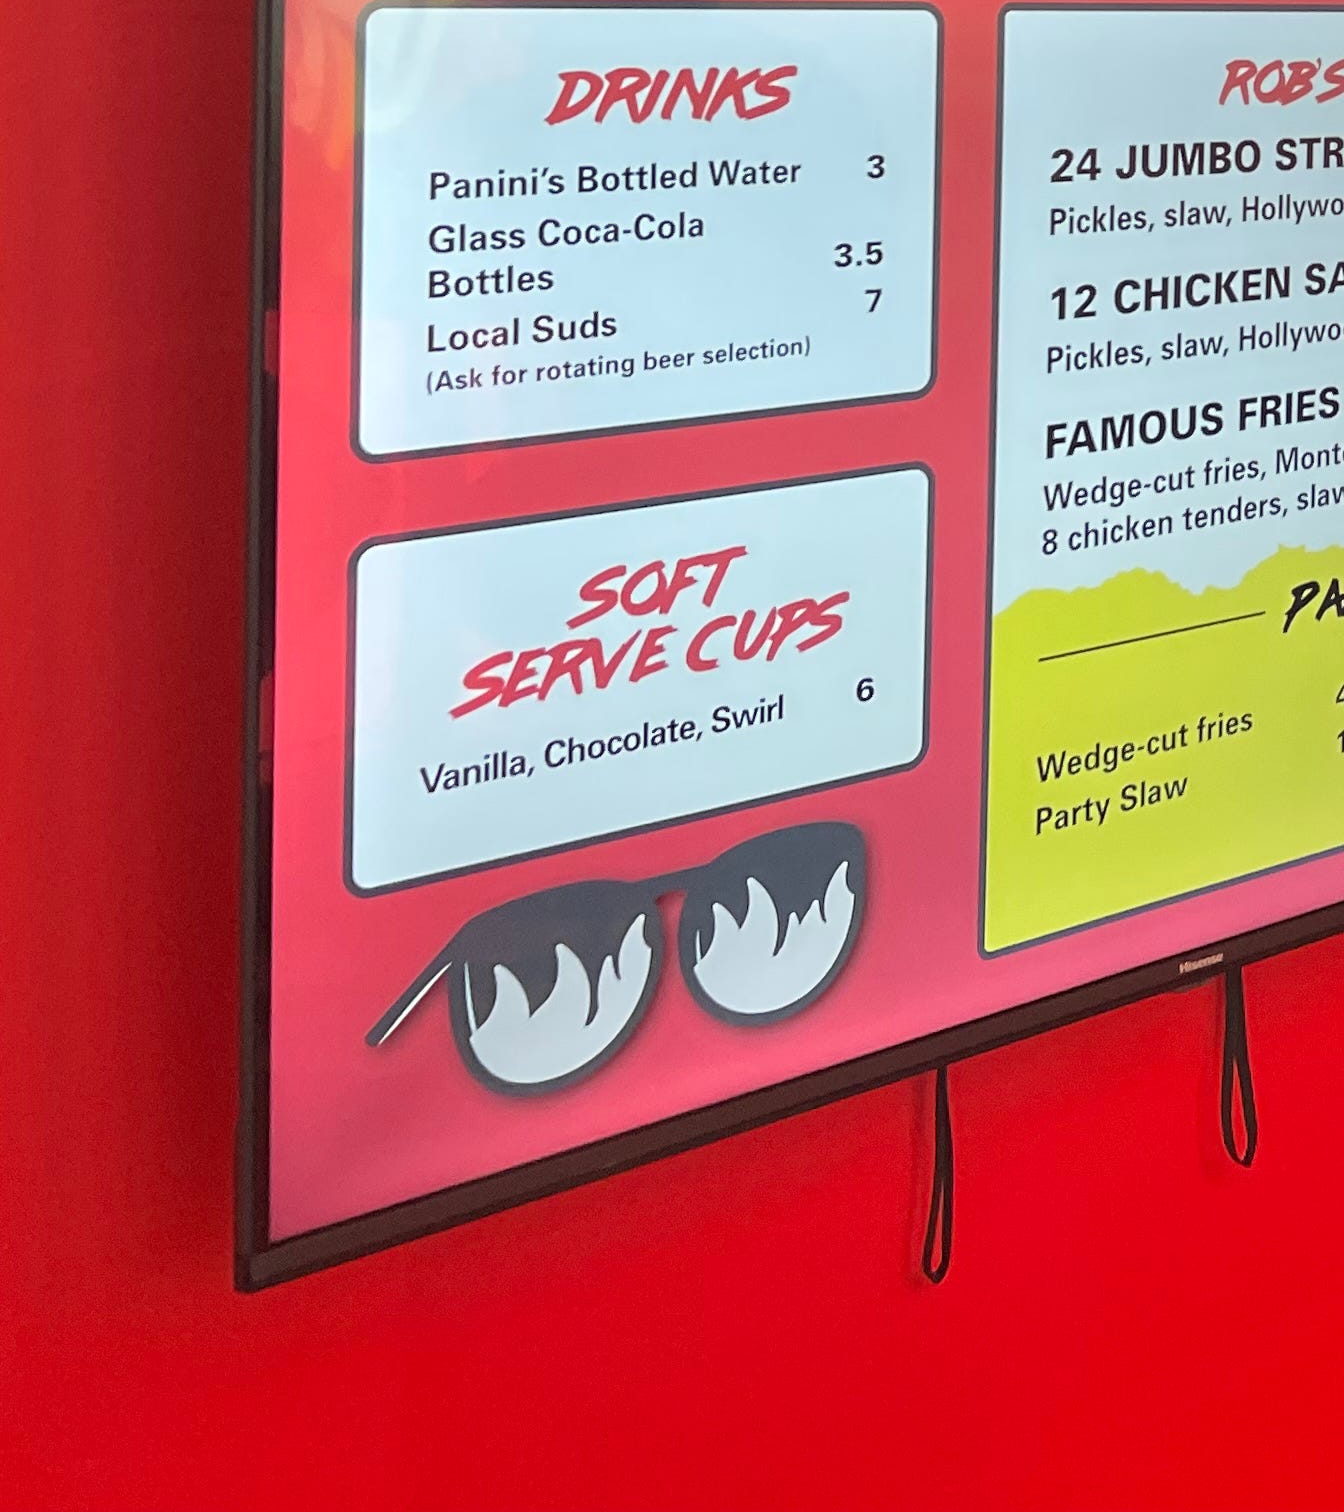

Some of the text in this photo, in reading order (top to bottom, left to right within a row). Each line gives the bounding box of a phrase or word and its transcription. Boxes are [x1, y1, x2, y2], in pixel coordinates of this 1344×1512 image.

[544, 65, 798, 125] DRINKS
[430, 160, 801, 200] Panini's Bottled Water
[867, 155, 884, 179] 3
[1051, 148, 1101, 182] 24
[1116, 140, 1261, 179] JUMBO
[429, 212, 703, 253] Glass Coca-Cola
[1050, 205, 1154, 235] Pickles,
[1165, 201, 1231, 227] slaw,
[835, 242, 883, 267] 3.5
[429, 266, 553, 298] Bottles
[865, 289, 882, 312] 7
[1052, 285, 1096, 320] 12
[1114, 266, 1290, 314] CHICKEN
[428, 311, 616, 352] Local Suds
[427, 337, 810, 394] (Ask for rotating beer selection)
[1047, 387, 1339, 459] FAMOUS FRIES
[1044, 466, 1195, 511] Wedge-cut
[1204, 457, 1265, 485] fries,
[566, 545, 748, 630] SOFT
[448, 591, 851, 720] SERVE CUPS
[857, 678, 874, 702] 6
[420, 694, 783, 793] Vanilla, Chocolate, Swirl
[1037, 713, 1252, 782] Wedge-cut fries
[1037, 778, 1187, 835] Party Slaw
